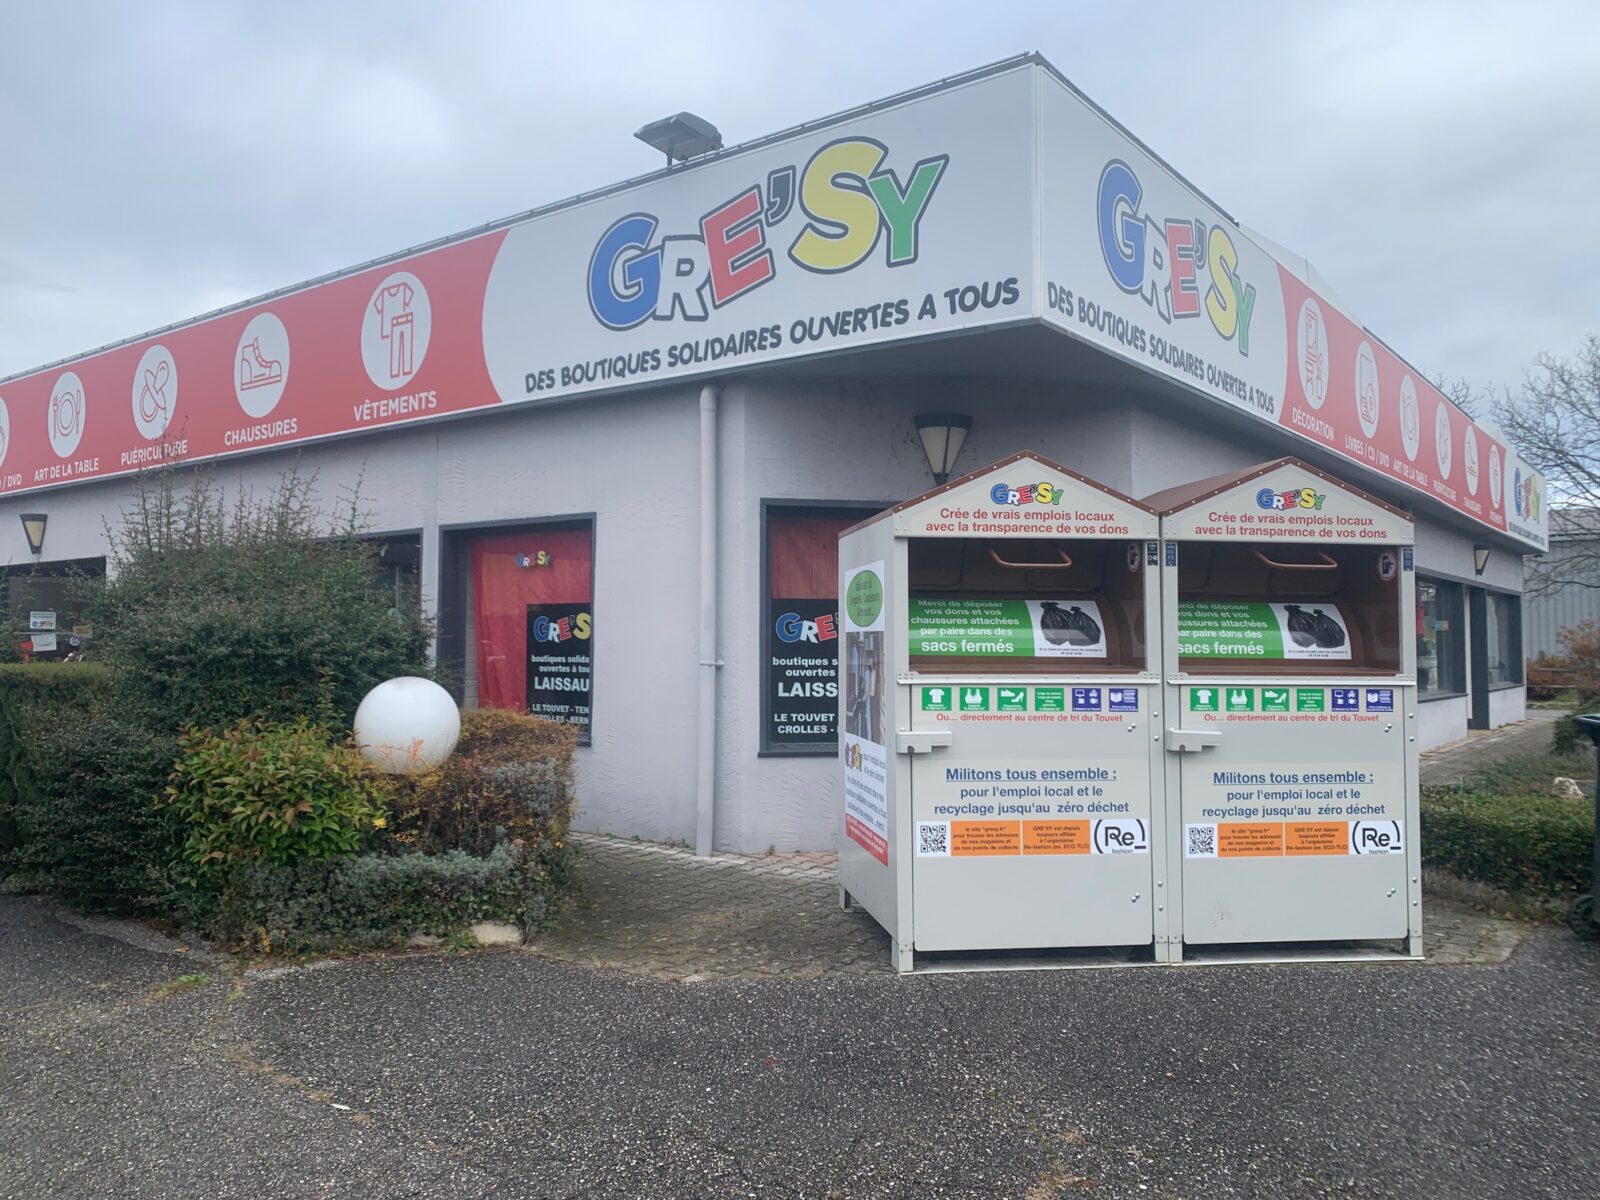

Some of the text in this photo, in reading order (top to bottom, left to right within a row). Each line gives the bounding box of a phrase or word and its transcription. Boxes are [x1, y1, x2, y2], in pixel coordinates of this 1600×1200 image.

[587, 136, 950, 332] GRE'SY
[1096, 158, 1257, 357] GRE'SY
[525, 277, 1020, 393] DES BOUTIQUES SOLIDAIRES OUVERTES A TOUS
[1048, 281, 1274, 414] DES BOUTIQUES SOLIDAIRES OUVERTES A TOUS
[352, 391, 437, 422] VÊTEMENTS
[1292, 405, 1335, 441] DÉCORATION
[224, 418, 298, 446] CHAUSSURES
[1345, 434, 1364, 456] LIVRES
[120, 439, 188, 467] PUÉRICULTURE
[34, 458, 100, 482] ART DE LA TABLE
[7, 474, 22, 487] DVD
[990, 482, 1063, 506] GRE'SY
[1256, 487, 1326, 511] GRE'SY
[940, 508, 1115, 523] Crée de vrais emplois locaux
[1208, 511, 1374, 527] Crée de vrais emplois locaux
[926, 521, 1129, 535] avec la transparence de vos dons
[1195, 525, 1387, 538] avec la transparence de vos dons
[515, 550, 551, 568] GRSY
[963, 600, 1003, 608] déposer
[911, 616, 1020, 625] chaussures attachées
[1195, 610, 1219, 618] dons
[1221, 619, 1268, 628] attachées
[920, 627, 1013, 636] par paire dans des
[1192, 629, 1263, 639] paire dans des
[921, 639, 1014, 653] sacs fermés
[1178, 641, 1264, 655] sacs fermés
[531, 655, 566, 664] boutiques
[772, 656, 828, 668] boutiques
[539, 665, 570, 673] ouvertes
[571, 664, 577, 673] à
[785, 668, 836, 677] ouvertes
[534, 676, 590, 692] LAISSAU
[778, 682, 838, 698] LAISS
[532, 704, 541, 712] LE
[542, 704, 570, 712] TOUVET
[774, 713, 835, 722] LE TOUVET
[960, 713, 1012, 721] directement
[1028, 714, 1055, 722] centre
[1057, 714, 1068, 722] de
[1070, 714, 1080, 722] tri
[1081, 714, 1092, 722] du
[1095, 714, 1123, 722] Touvet
[1227, 714, 1276, 722] directement
[1290, 714, 1316, 722] centre
[1318, 714, 1328, 722] de
[1330, 714, 1339, 722] tri
[1340, 714, 1351, 722] du
[1353, 714, 1379, 722] Touvet
[778, 725, 828, 734] CROLLES
[946, 768, 1001, 781] Militons
[1006, 769, 1037, 780] tous
[1042, 767, 1109, 780] ensemble
[1213, 772, 1266, 784] Militons
[1270, 773, 1299, 784] tous
[1303, 771, 1366, 783] ensemble
[960, 786, 1103, 799] pour l'emploi local et le
[1227, 789, 1361, 802] pour l'emploi local et le
[934, 801, 1129, 816] recyclage jusqu'au zéro déchet
[1202, 804, 1385, 819] recyclage jusqu'au zéro déchet
